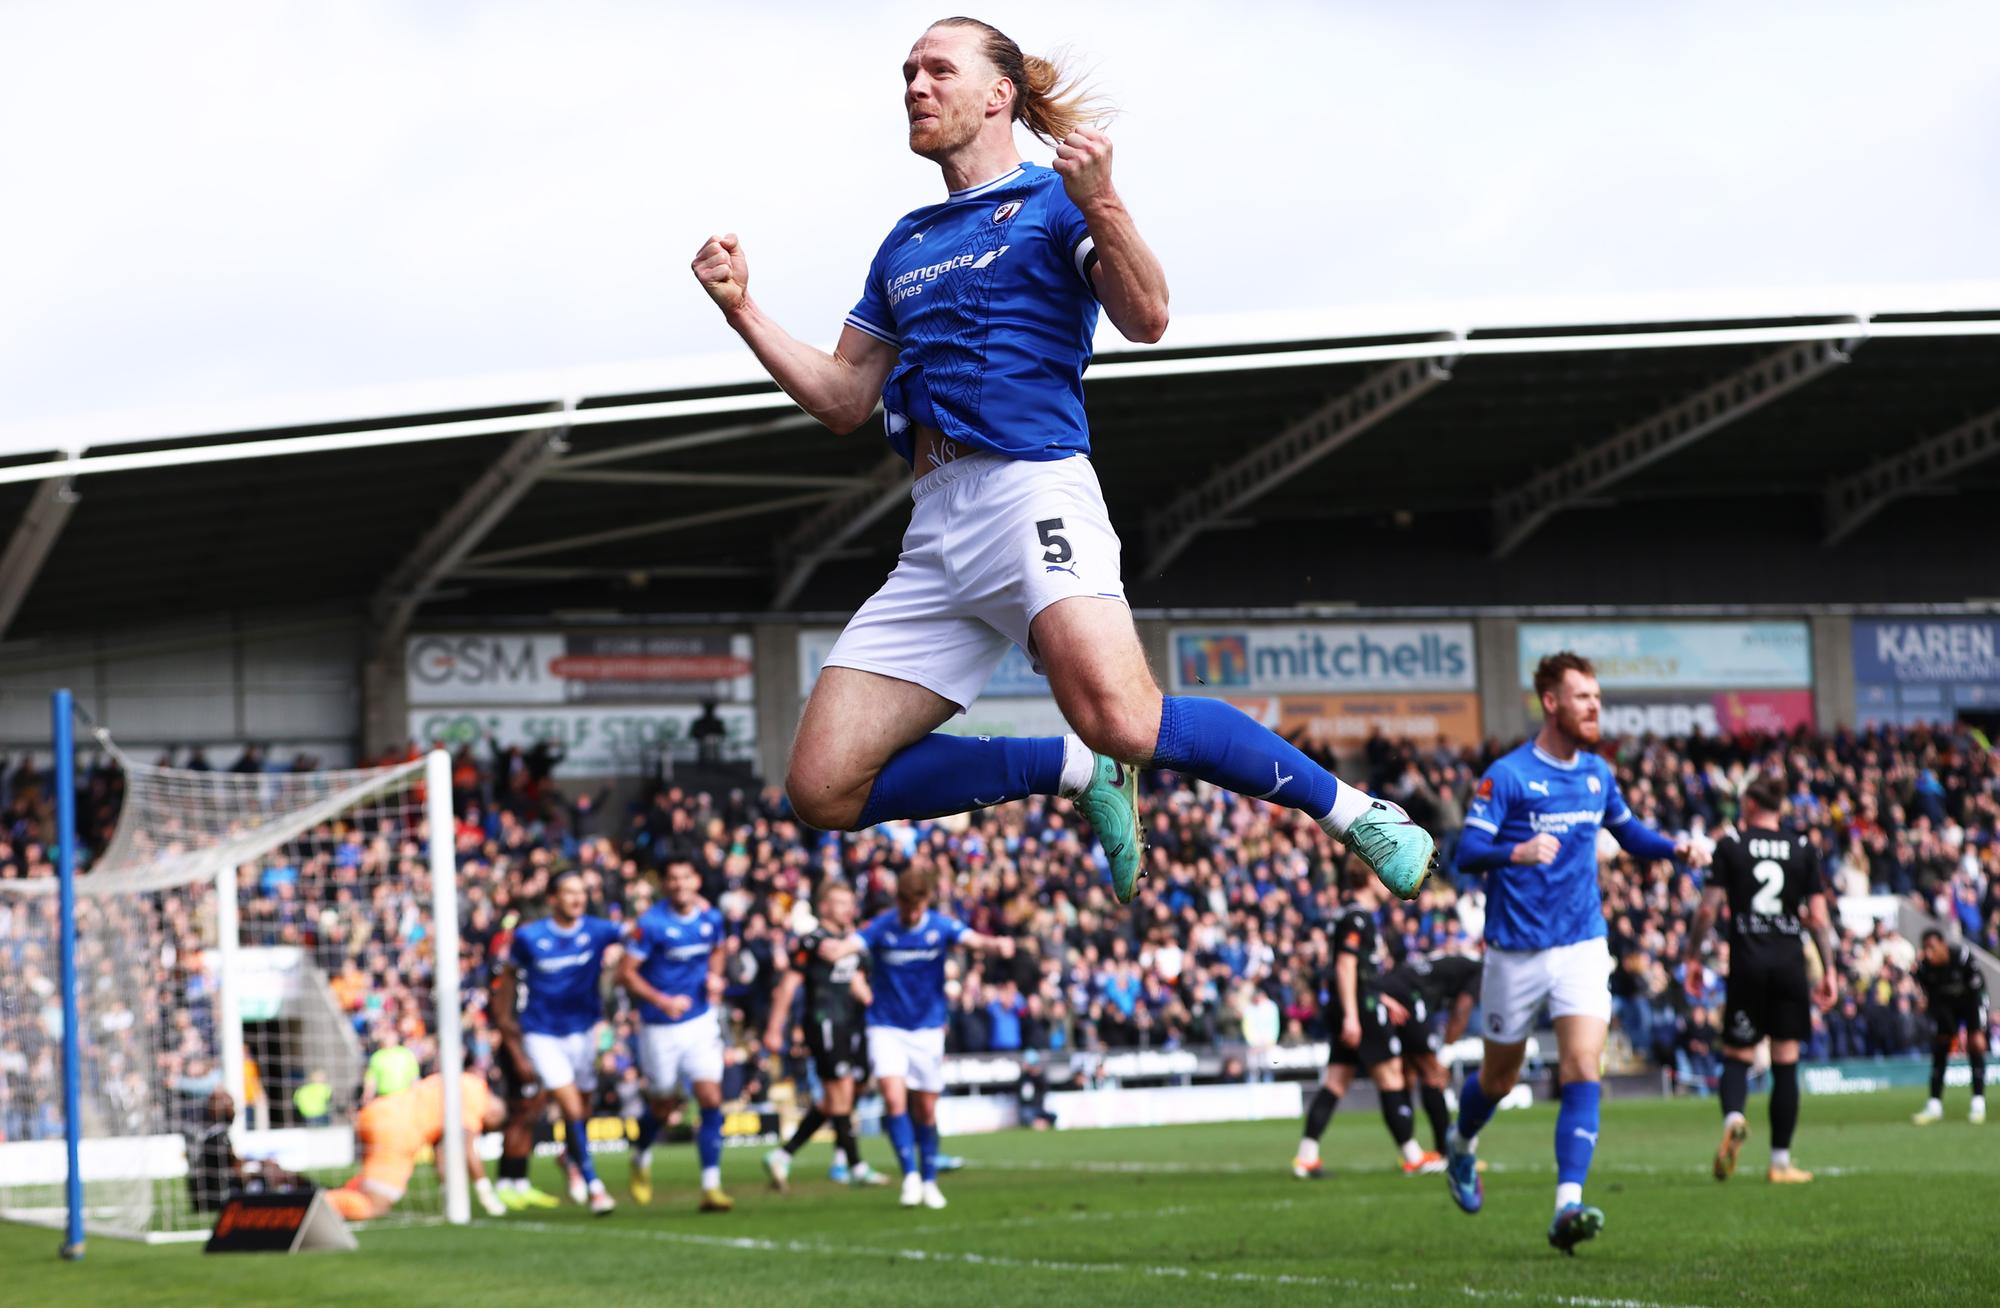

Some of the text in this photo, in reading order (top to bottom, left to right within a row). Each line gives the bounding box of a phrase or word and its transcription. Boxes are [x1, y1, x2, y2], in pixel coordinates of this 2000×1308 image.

[887, 254, 974, 294] Leengate
[1036, 518, 1072, 563] 5
[411, 637, 537, 685] GSM
[1255, 632, 1466, 678] mitchells
[1876, 625, 1995, 664] KAREN
[1752, 860, 1784, 914] 2
